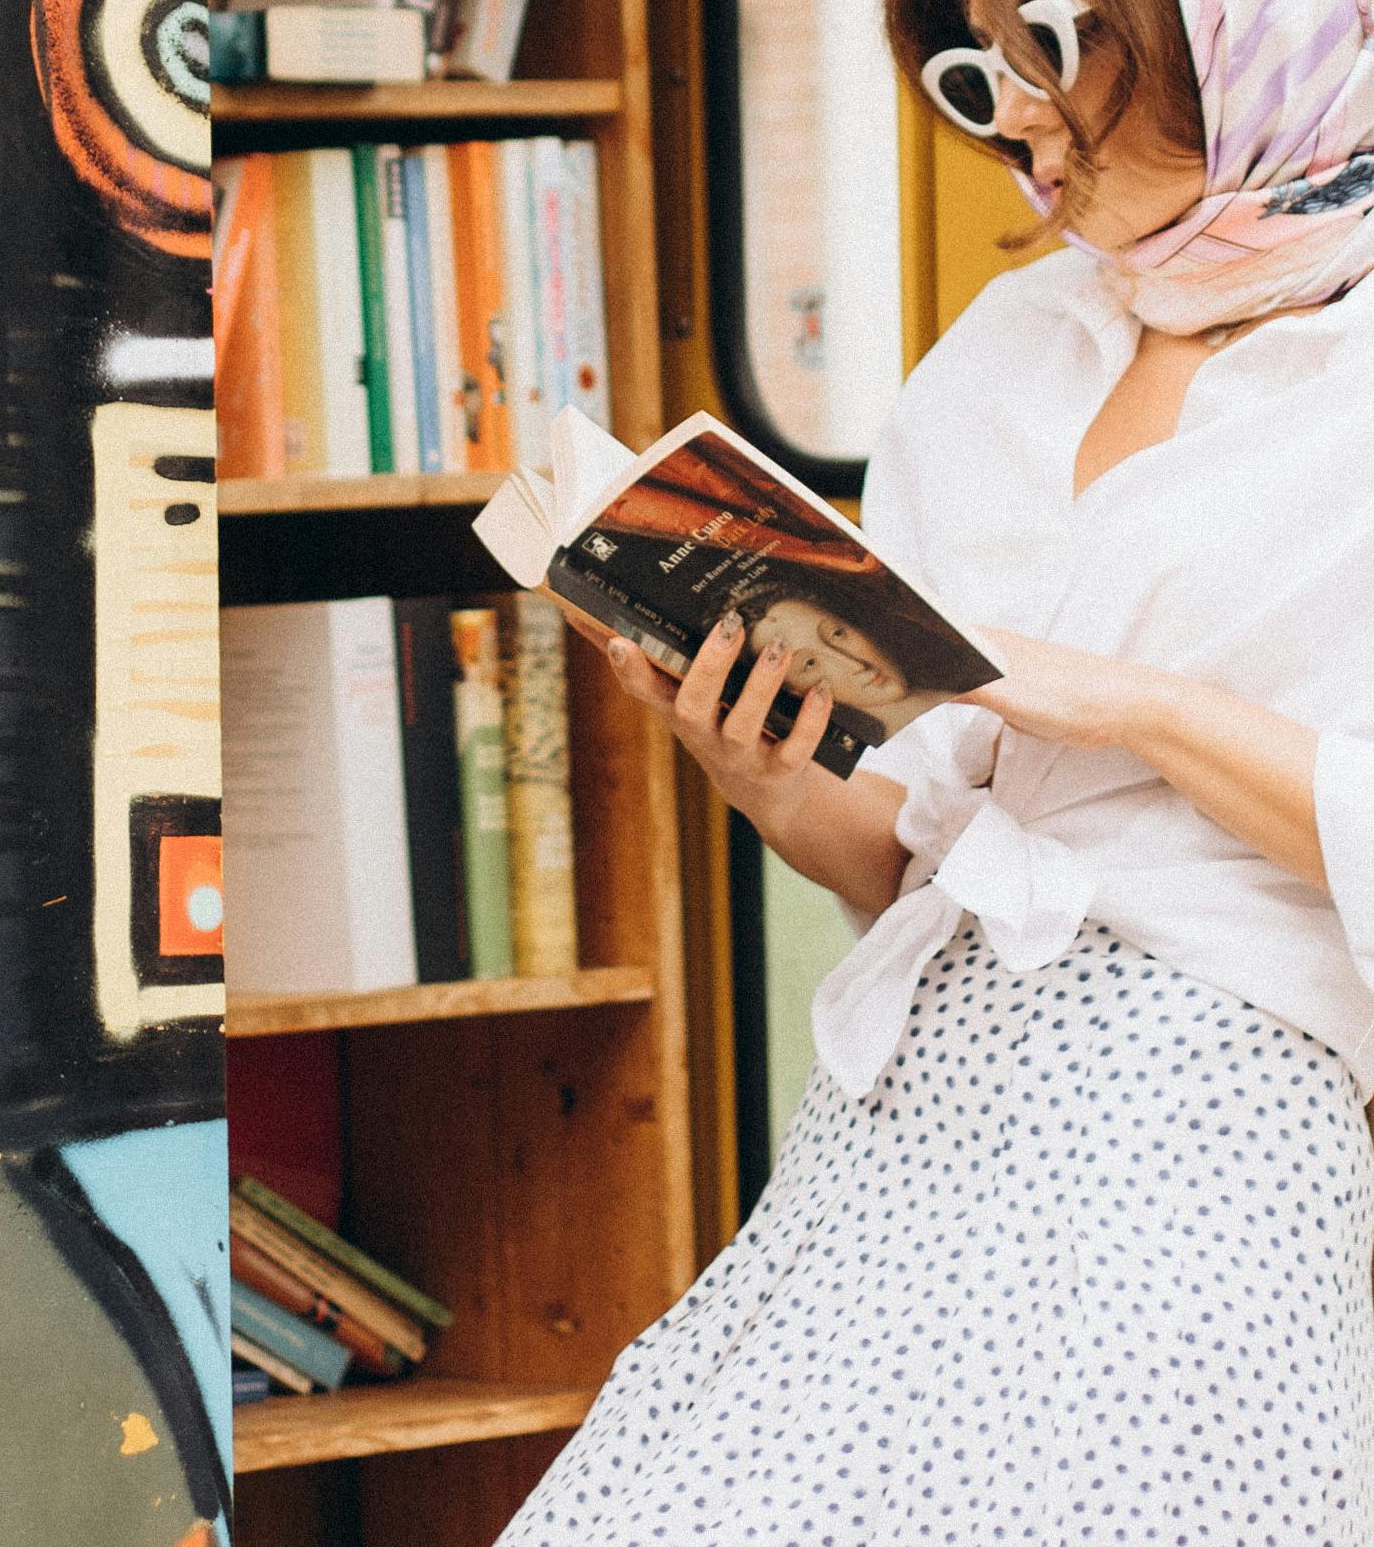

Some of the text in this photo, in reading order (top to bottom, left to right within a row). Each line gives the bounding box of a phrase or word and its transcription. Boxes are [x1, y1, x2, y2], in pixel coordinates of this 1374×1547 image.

[720, 505, 777, 548] Dark Lady
[659, 510, 734, 574] Anne Cuneo
[582, 569, 606, 589] Lady
[691, 578, 708, 593] Der
[706, 561, 732, 581] Roman
[606, 584, 630, 604] Dark
[633, 601, 662, 624] Cuneo
